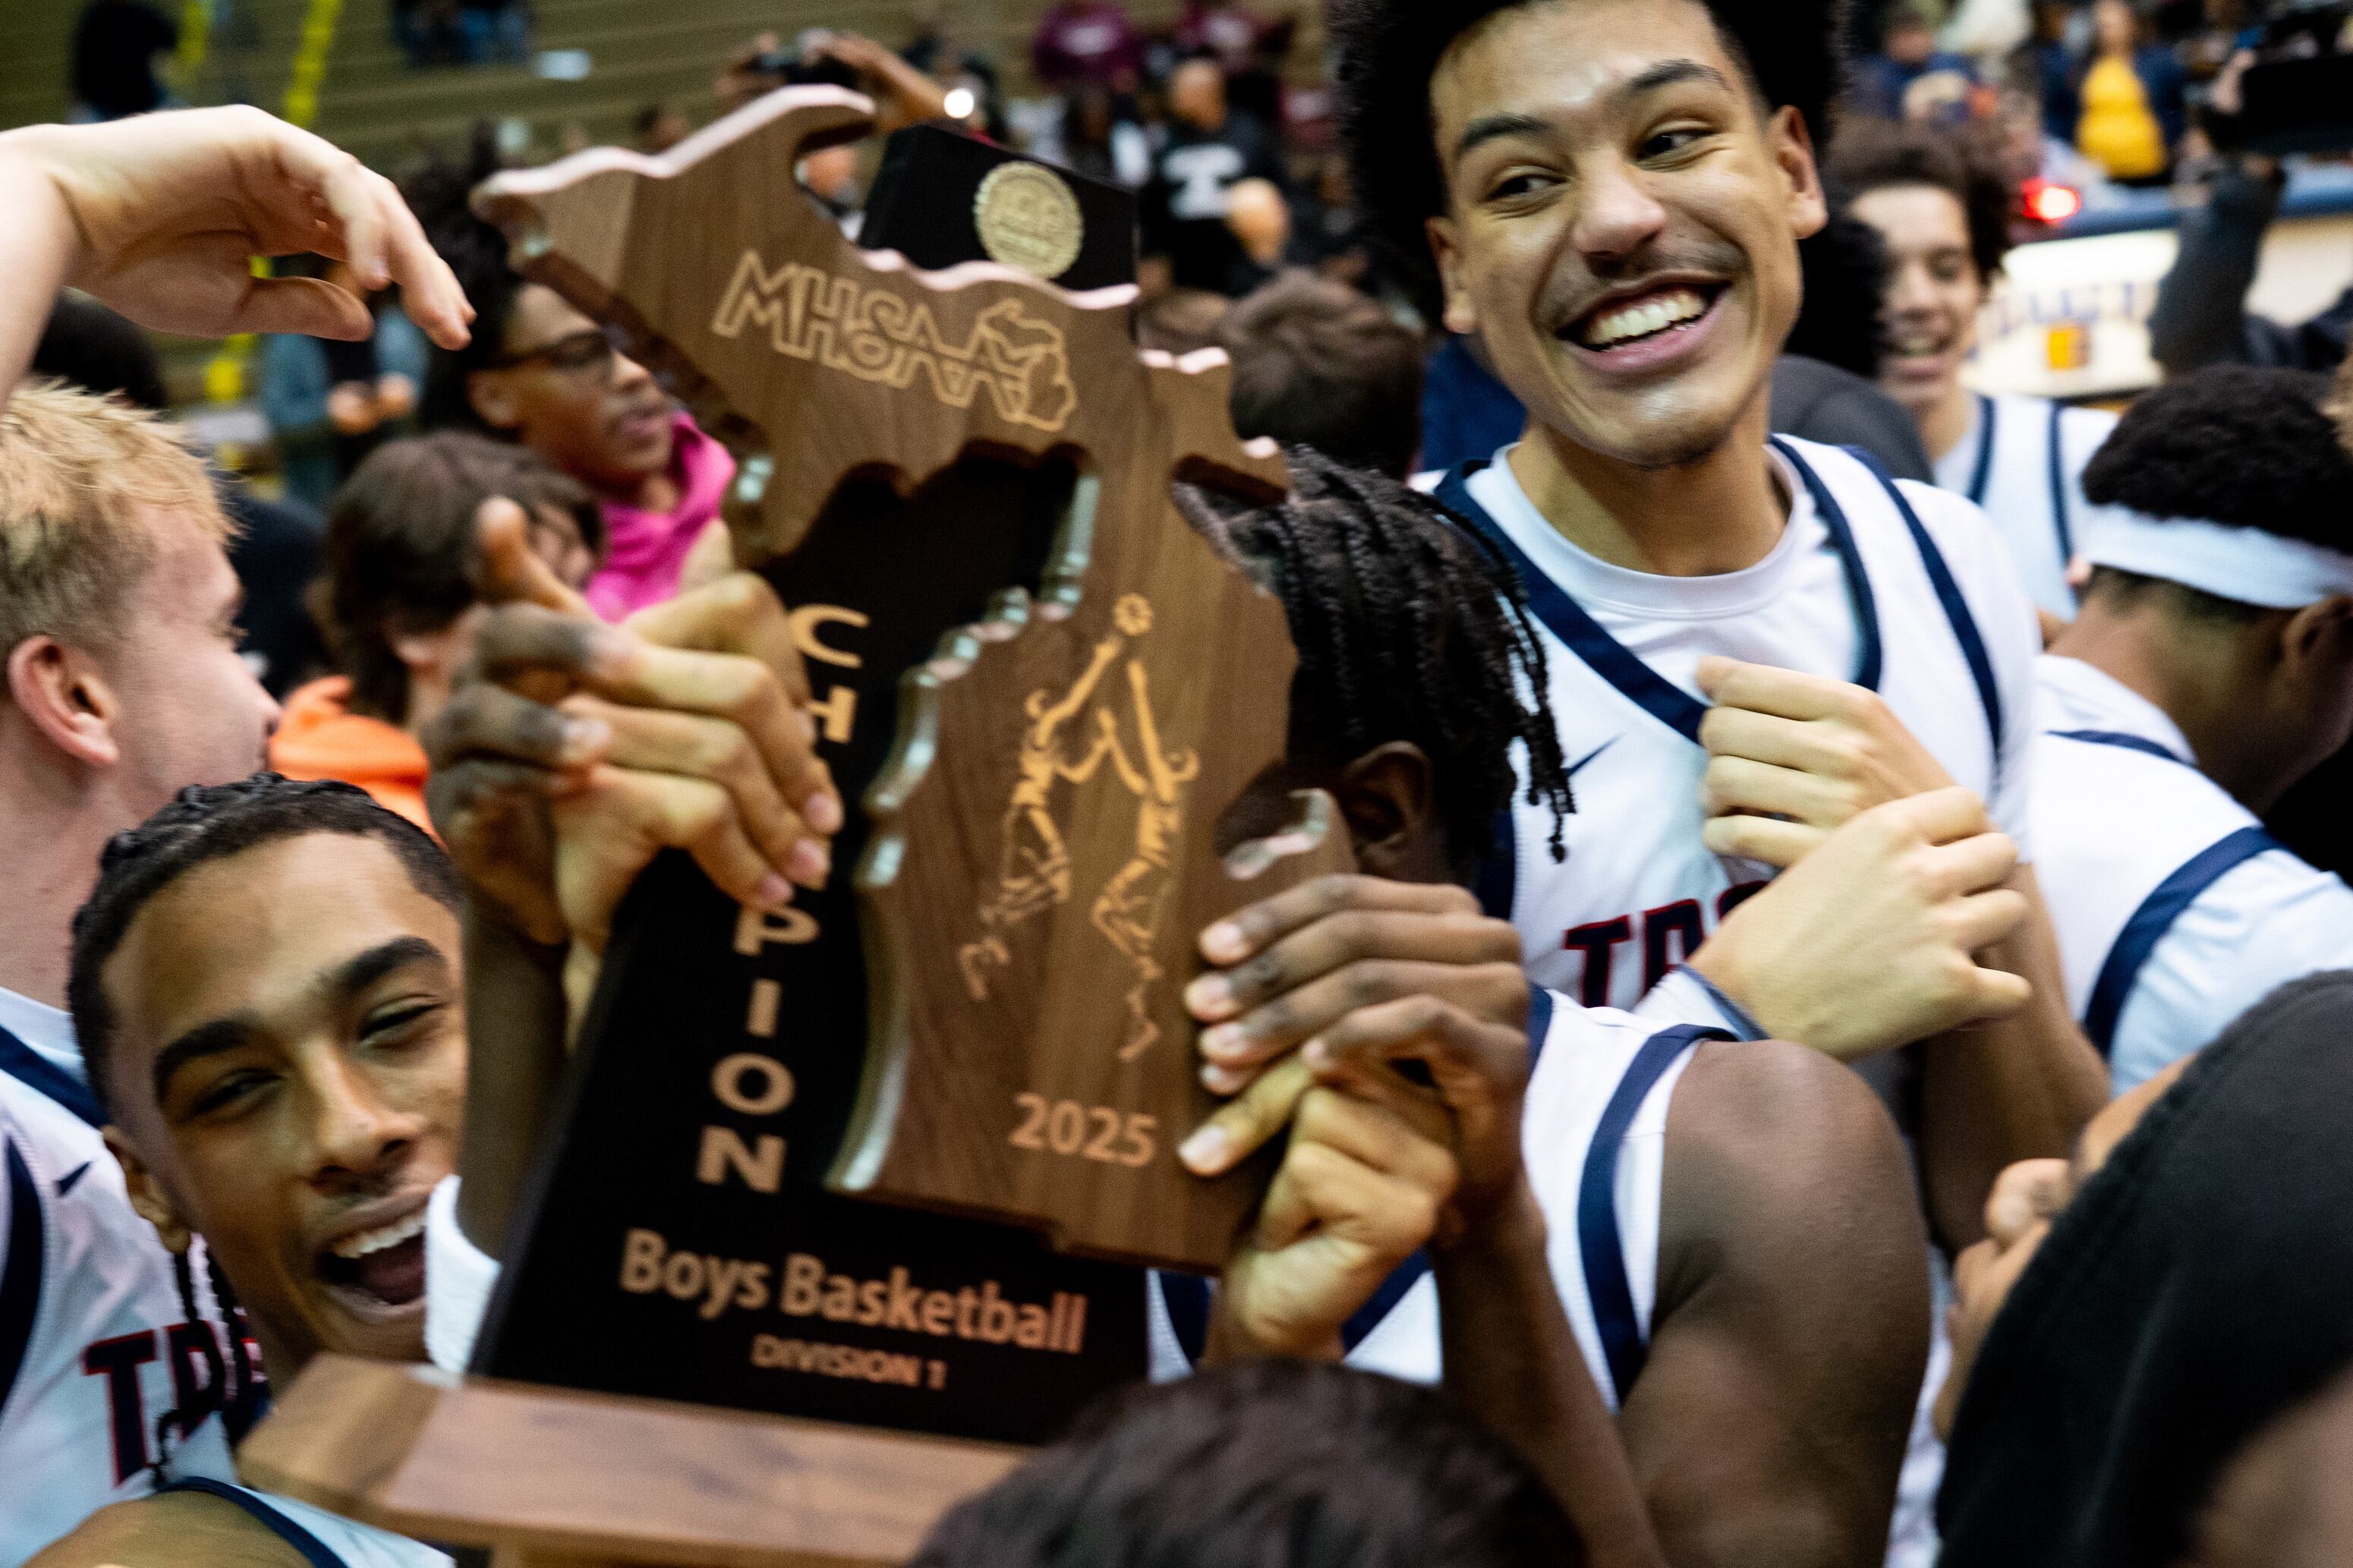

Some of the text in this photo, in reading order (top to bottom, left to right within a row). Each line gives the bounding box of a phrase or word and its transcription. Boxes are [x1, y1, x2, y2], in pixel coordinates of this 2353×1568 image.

[711, 249, 1035, 425] MHSAA
[695, 603, 870, 1195] CHPION
[1009, 1093, 1158, 1167] 2025
[619, 1227, 1088, 1355] Boys Basketball
[750, 1333, 947, 1390] DIVISION 1
